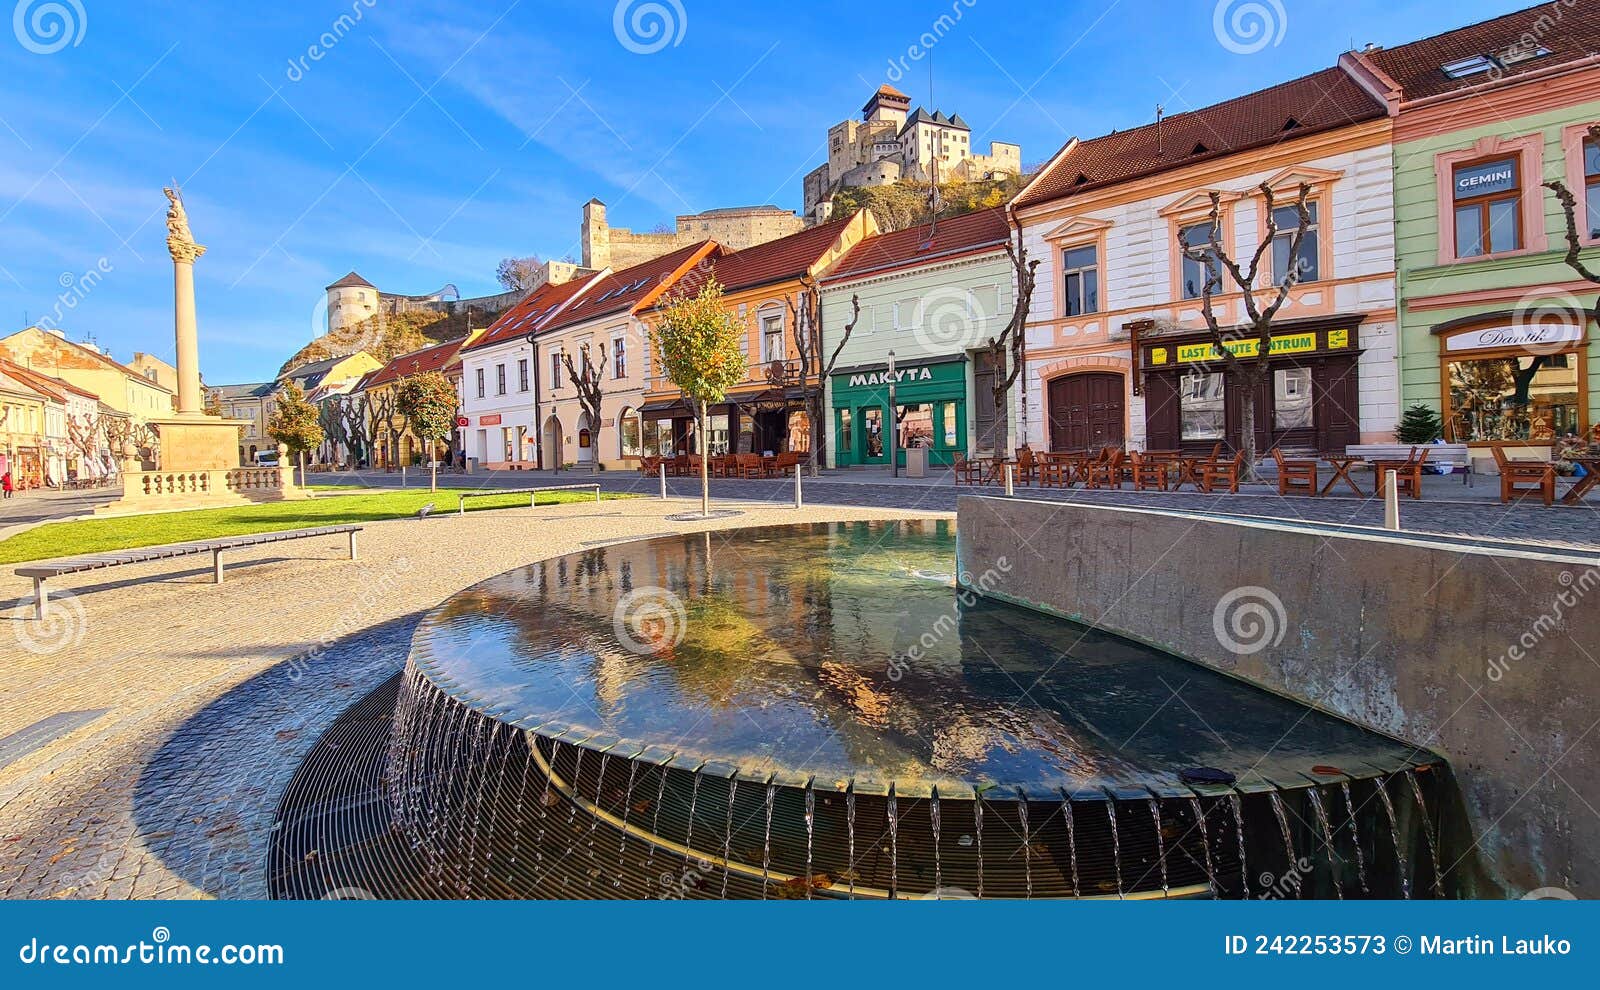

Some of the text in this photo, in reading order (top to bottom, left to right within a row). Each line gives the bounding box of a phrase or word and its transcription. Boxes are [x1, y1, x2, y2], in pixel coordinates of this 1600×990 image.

[1459, 169, 1512, 187] GEMINI
[1181, 347, 1206, 359] LAST
[1208, 343, 1252, 357] MNUTE
[1255, 337, 1312, 353] CNTRUM
[849, 367, 933, 387] MAKYTA
